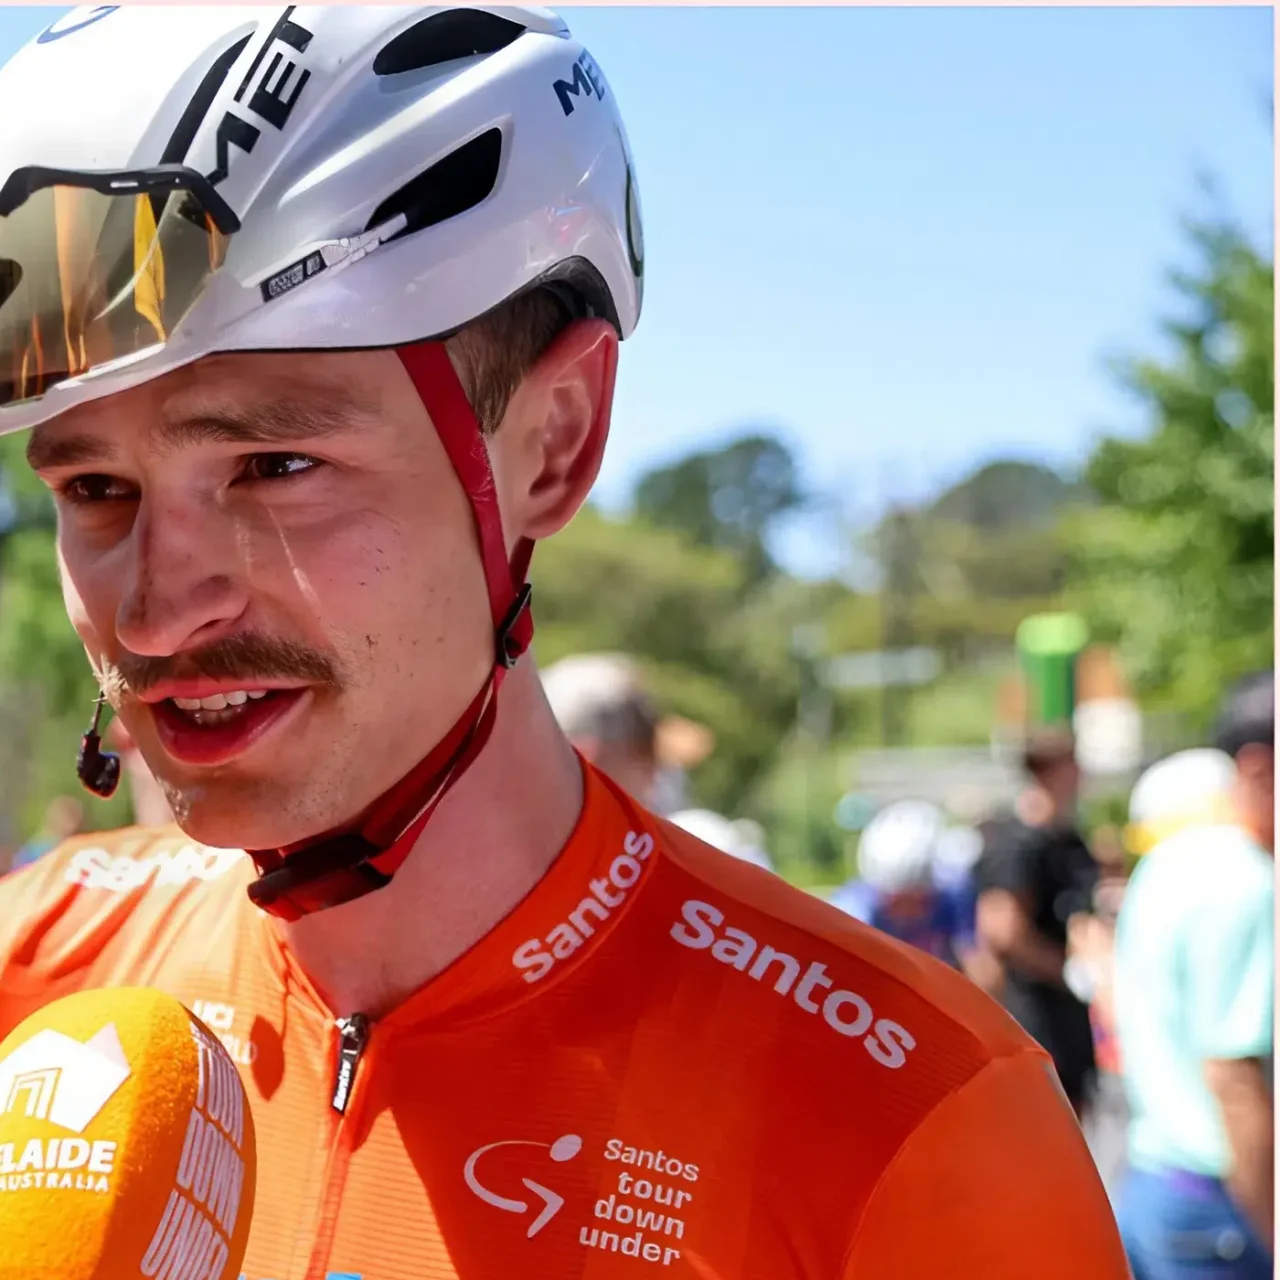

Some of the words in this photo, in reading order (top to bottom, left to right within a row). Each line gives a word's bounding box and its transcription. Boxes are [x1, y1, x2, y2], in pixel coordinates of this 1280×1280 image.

[203, 5, 314, 187] MET
[512, 830, 654, 984] Santos
[669, 899, 917, 1070] Santos
[603, 1138, 700, 1182] Santos
[618, 1171, 693, 1209] tour
[593, 1194, 686, 1240] down
[578, 1225, 681, 1266] under
